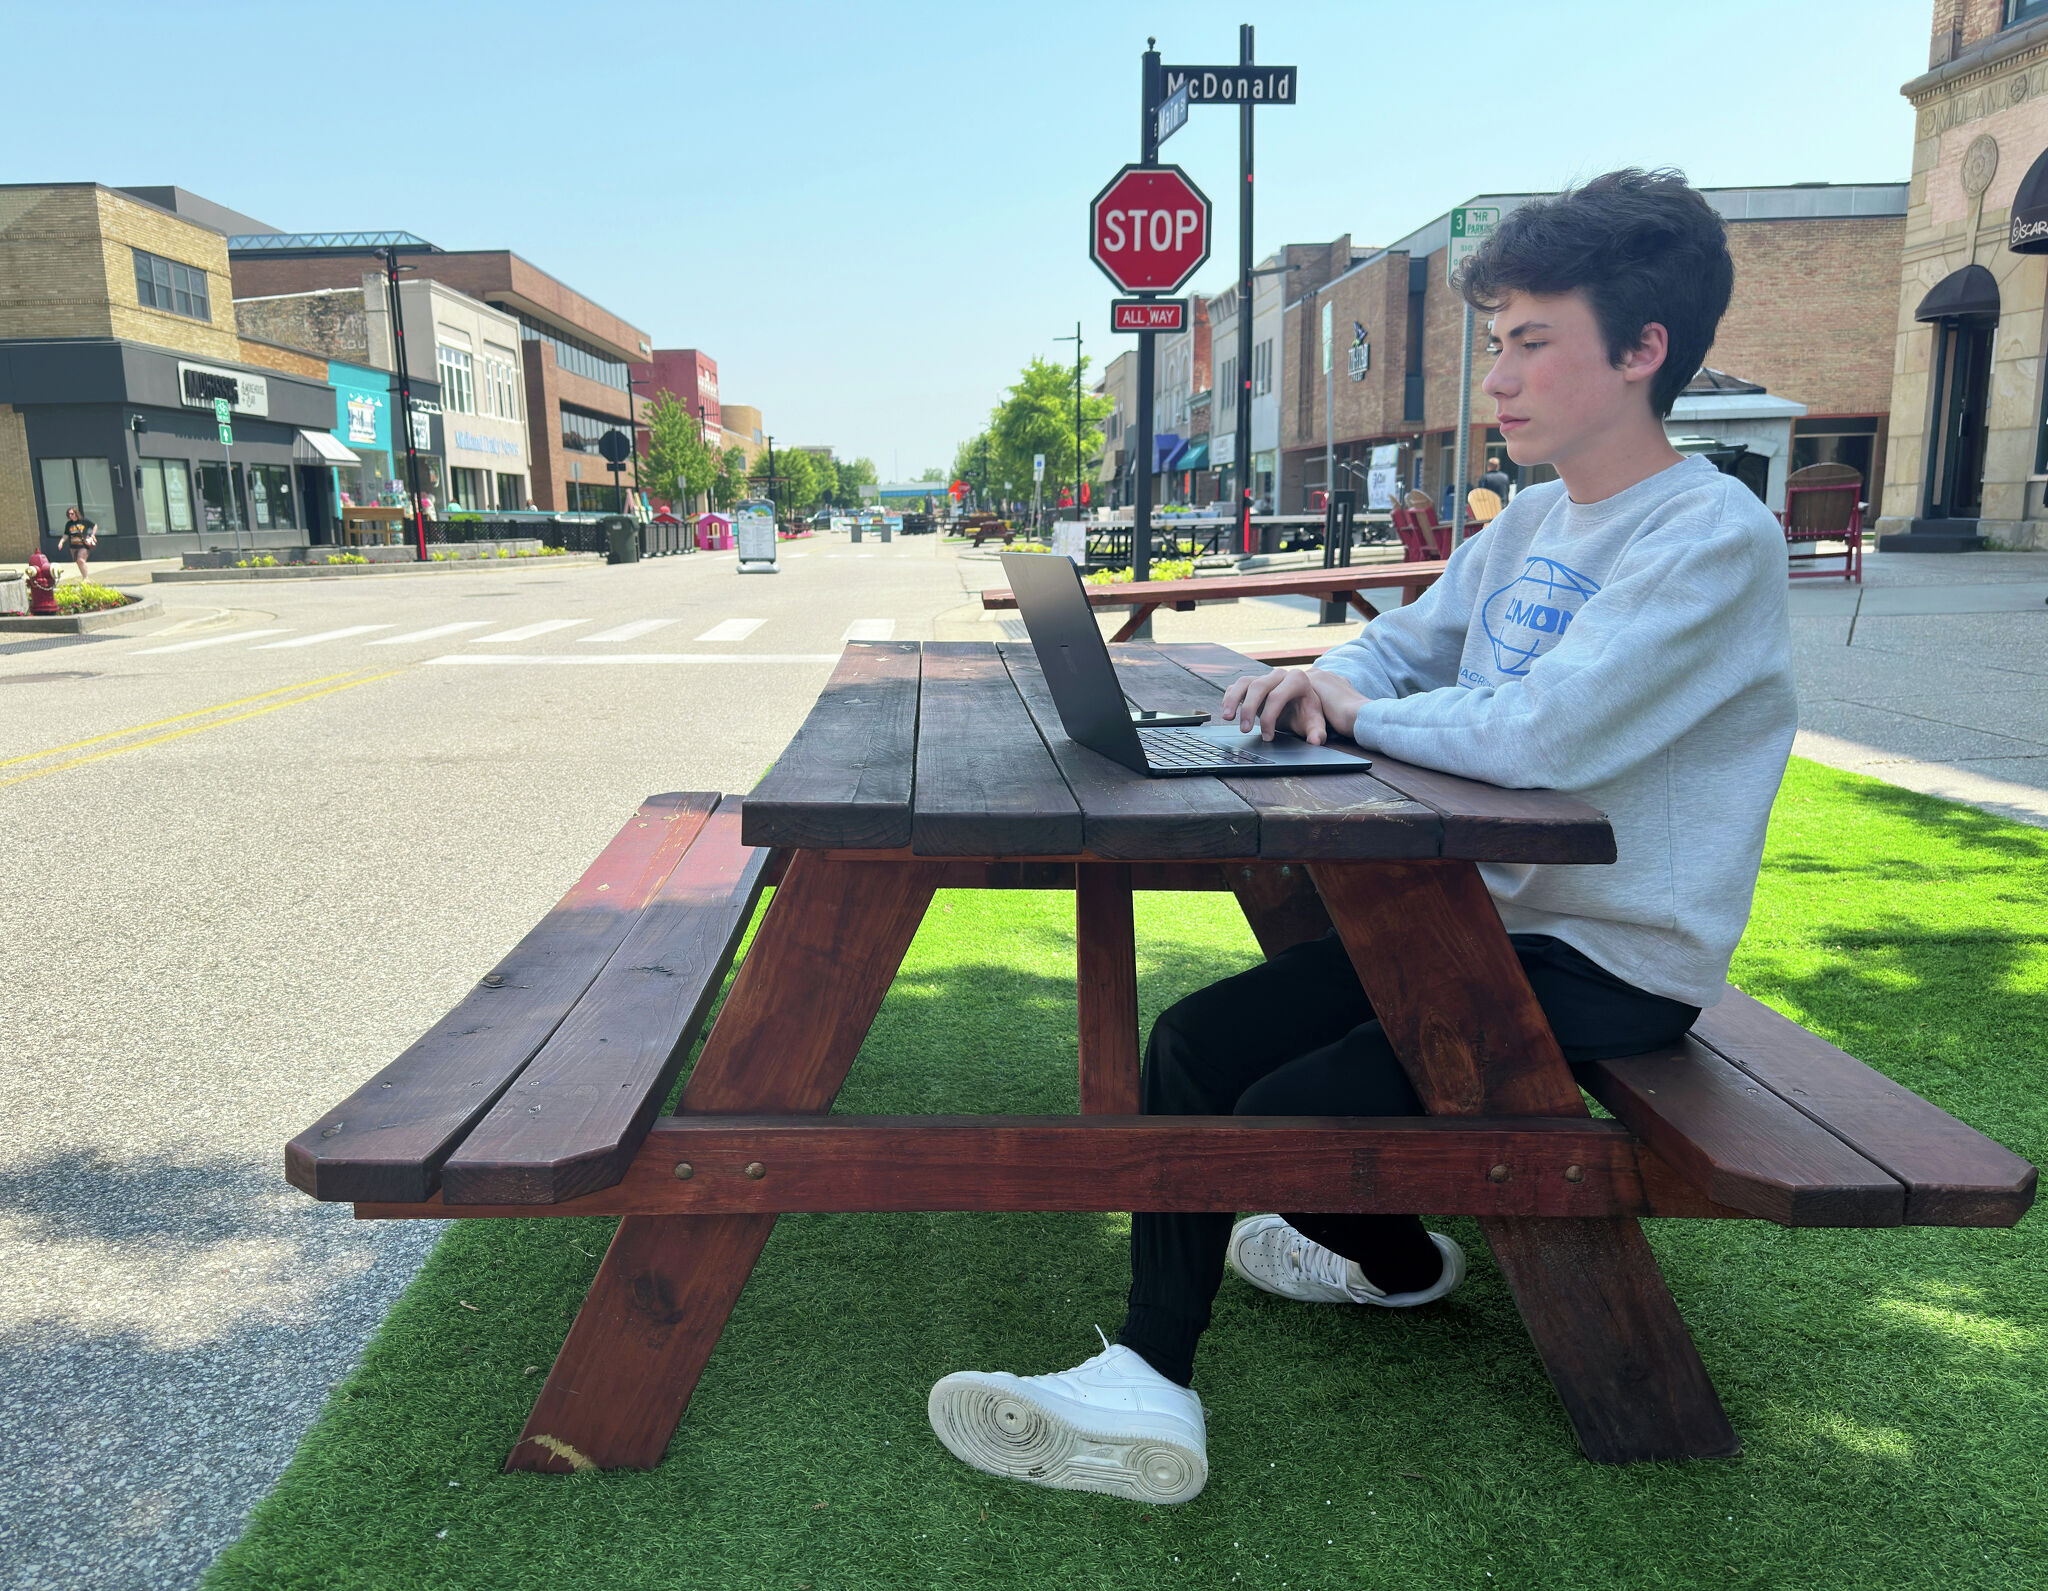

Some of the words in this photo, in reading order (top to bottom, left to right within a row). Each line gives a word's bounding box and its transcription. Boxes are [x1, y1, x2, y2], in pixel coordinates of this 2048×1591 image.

[1167, 72, 1289, 99] McDonald
[1938, 82, 2007, 129] MIDLAND
[1159, 101, 1179, 140] Main
[1104, 209, 1198, 252] STOP
[1455, 214, 1463, 231] 3
[1475, 211, 1488, 222] HR
[2012, 216, 2048, 244] OSCAR
[1122, 309, 1145, 324] ALL
[1150, 309, 1175, 324] WAY
